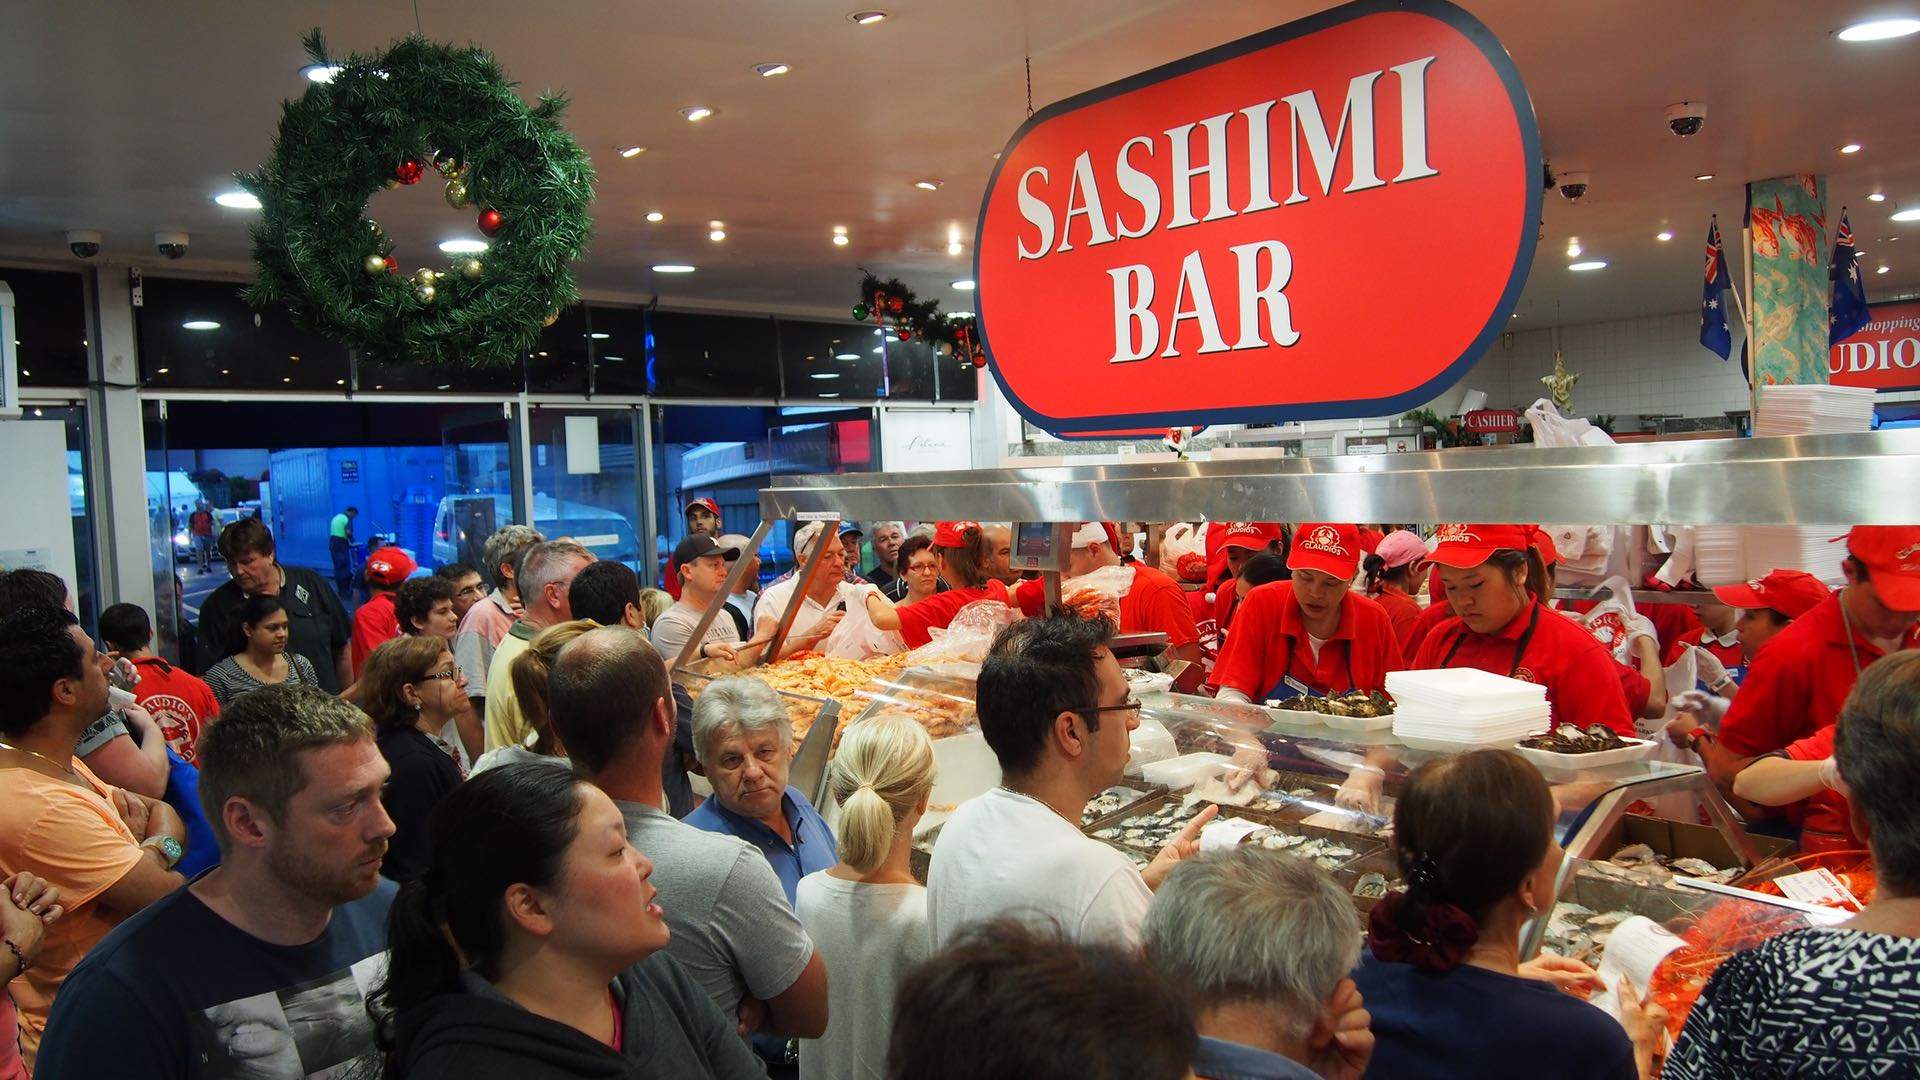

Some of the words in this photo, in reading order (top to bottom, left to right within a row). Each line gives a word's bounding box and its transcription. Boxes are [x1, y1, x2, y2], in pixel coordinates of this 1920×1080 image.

[1017, 55, 1440, 262] SASHIMI
[1106, 239, 1301, 365] BAR
[1829, 337, 1920, 374] UDIO
[1468, 414, 1514, 428] CASHIER
[1304, 542, 1341, 556] CLAUDIOS
